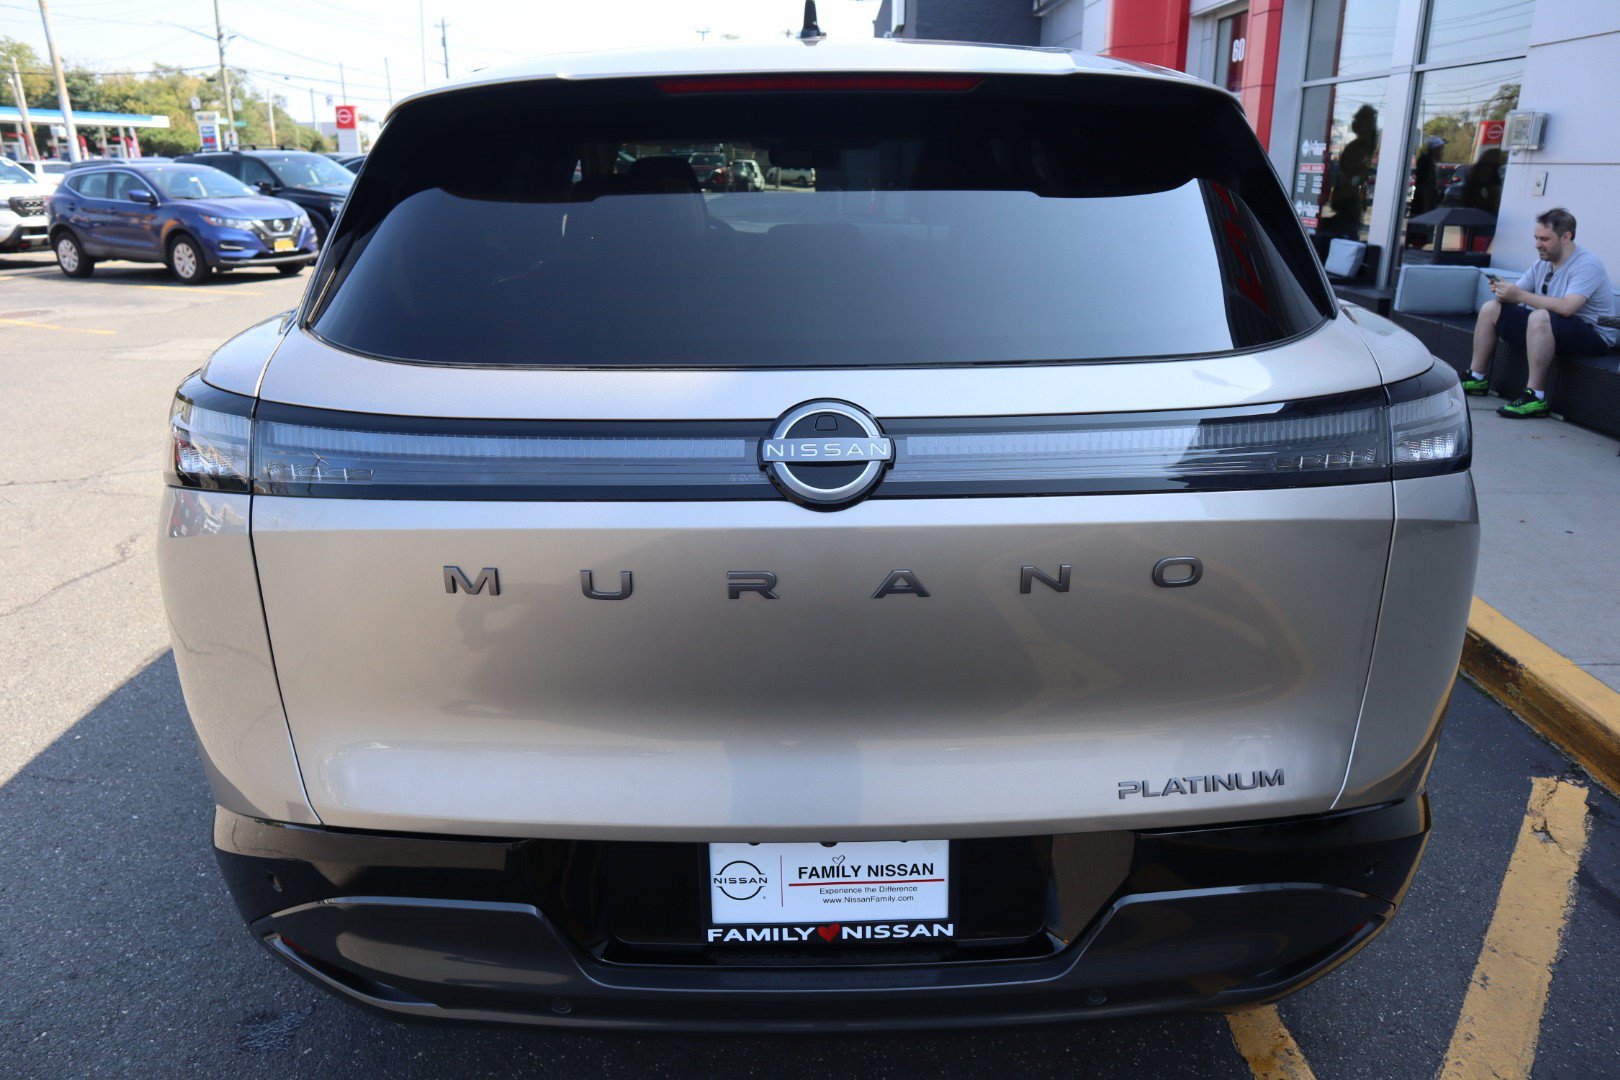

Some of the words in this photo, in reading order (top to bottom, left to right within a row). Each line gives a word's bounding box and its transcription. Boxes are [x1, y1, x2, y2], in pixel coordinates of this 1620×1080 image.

[1232, 37, 1246, 62] 60
[766, 442, 888, 457] NISSAN
[443, 555, 1204, 601] MURANO
[1118, 768, 1285, 799] PLATINUM
[798, 865, 862, 879] FAMILY
[867, 862, 934, 878] NISSAN
[819, 887, 862, 895] Experience
[879, 885, 918, 893] Difference
[822, 895, 914, 904] www.NissanFamily.com
[707, 926, 816, 942] FAMILY
[841, 923, 954, 940] NISSAN
